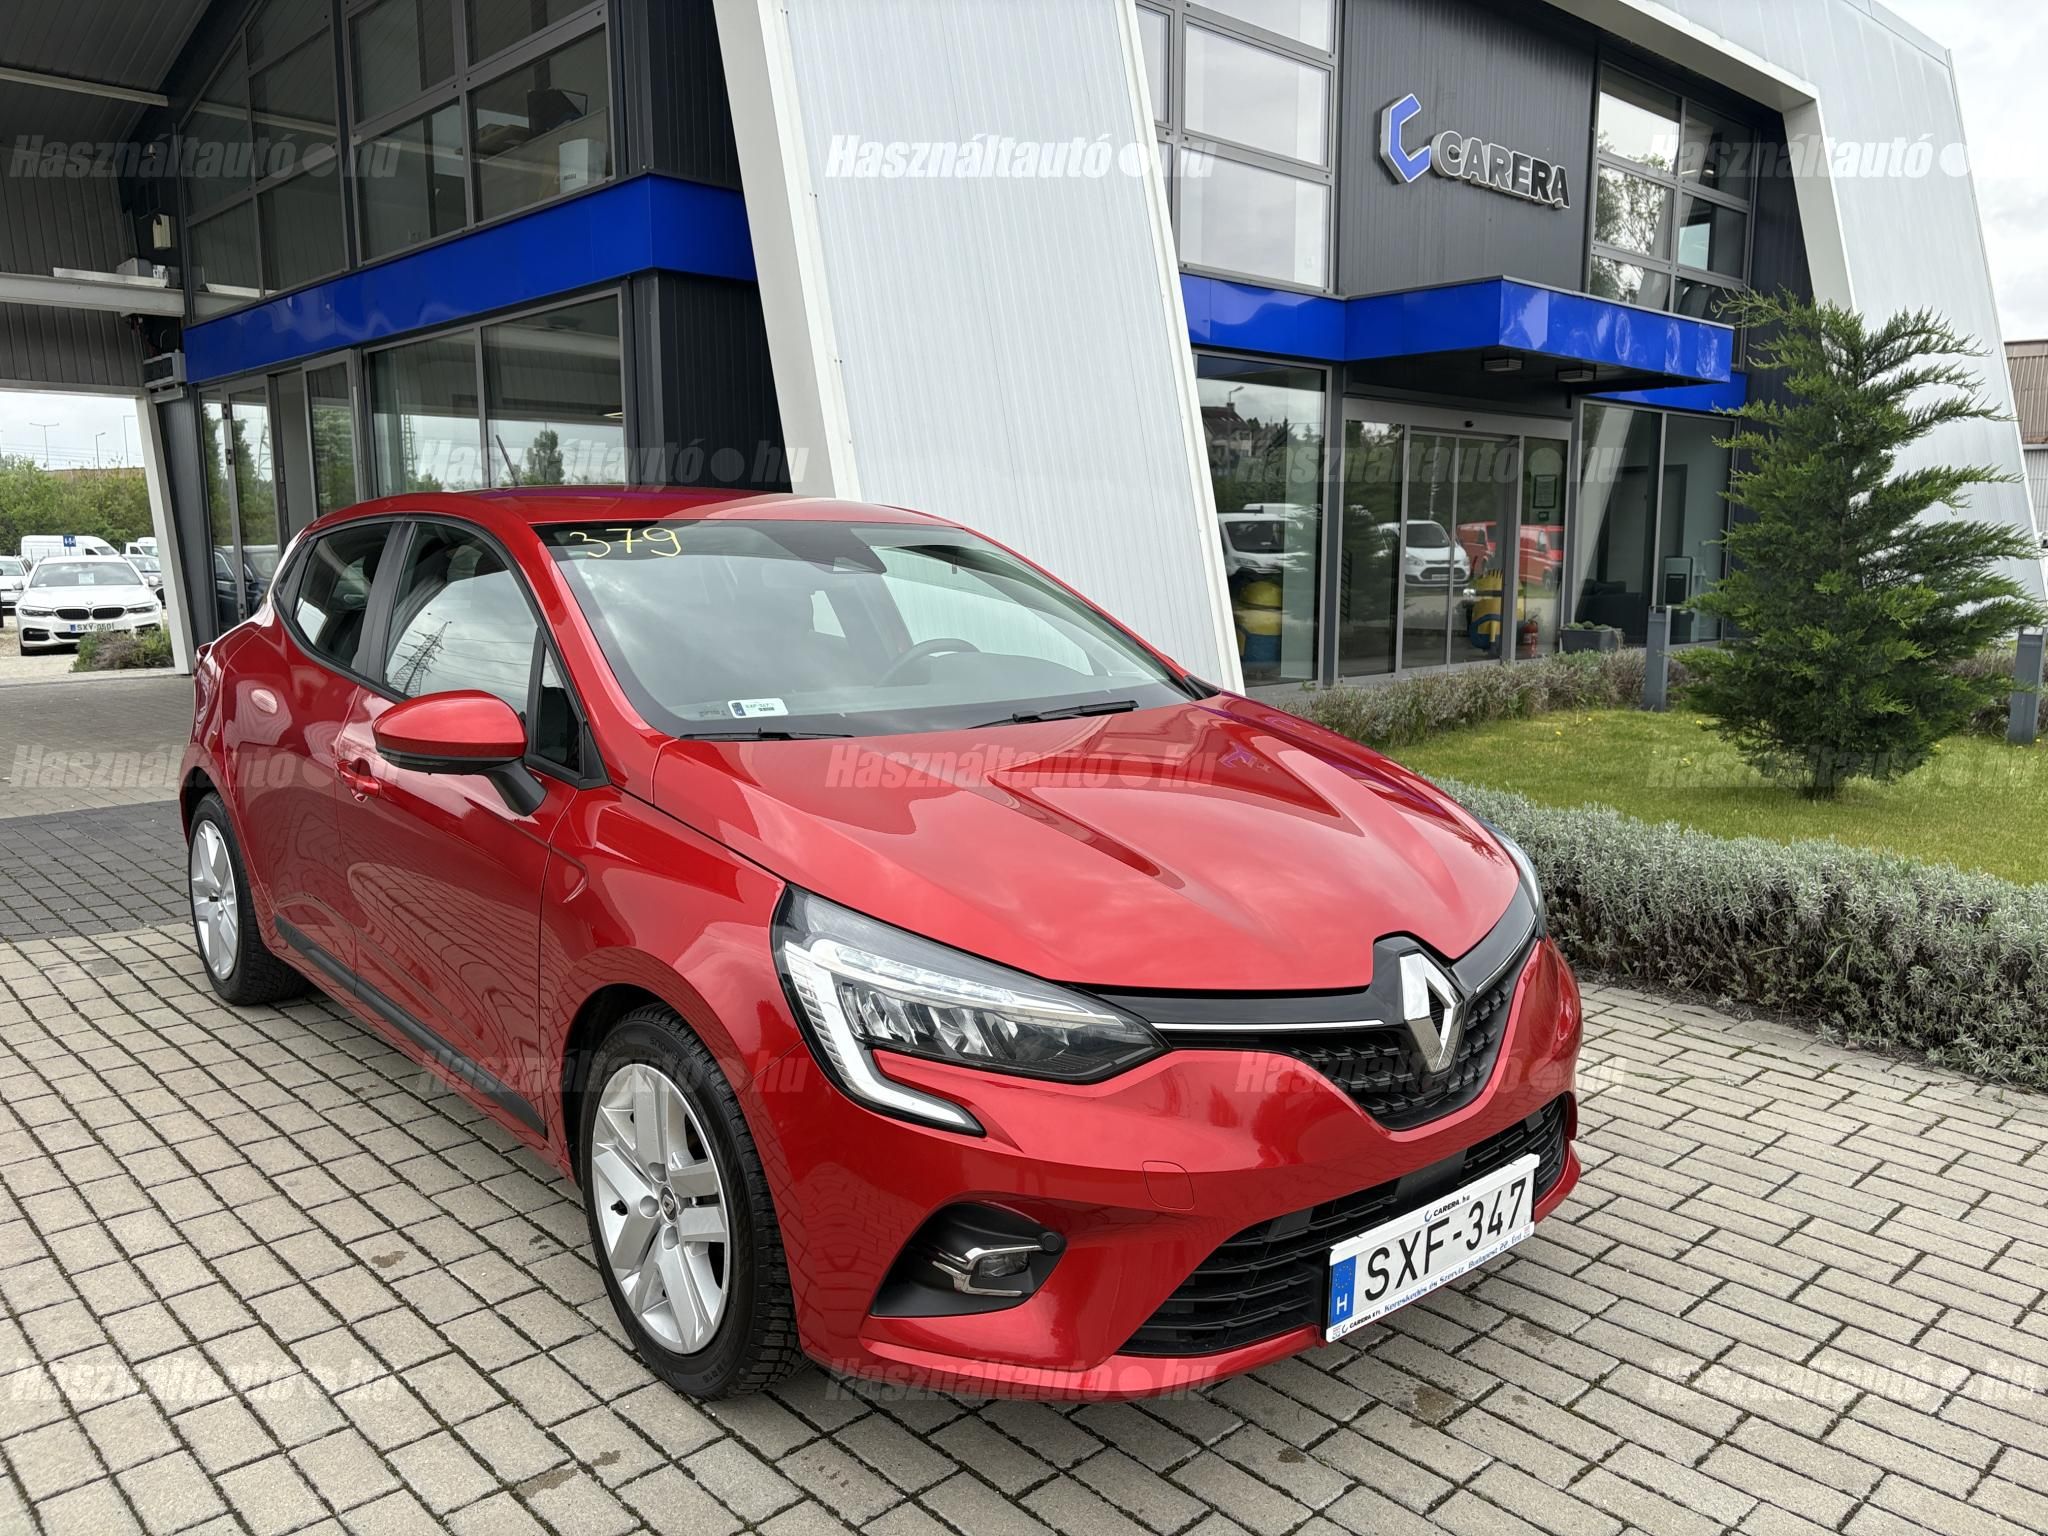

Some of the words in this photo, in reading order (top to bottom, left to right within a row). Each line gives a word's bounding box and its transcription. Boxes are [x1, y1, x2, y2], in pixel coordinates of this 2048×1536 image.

[1432, 130, 1570, 208] CARERA
[569, 527, 682, 558] 379
[1364, 1177, 1527, 1301] SXF-347
[1335, 1292, 1348, 1315] H
[1349, 1314, 1372, 1329] CARERA
[1439, 1266, 1465, 1283] Szerviz
